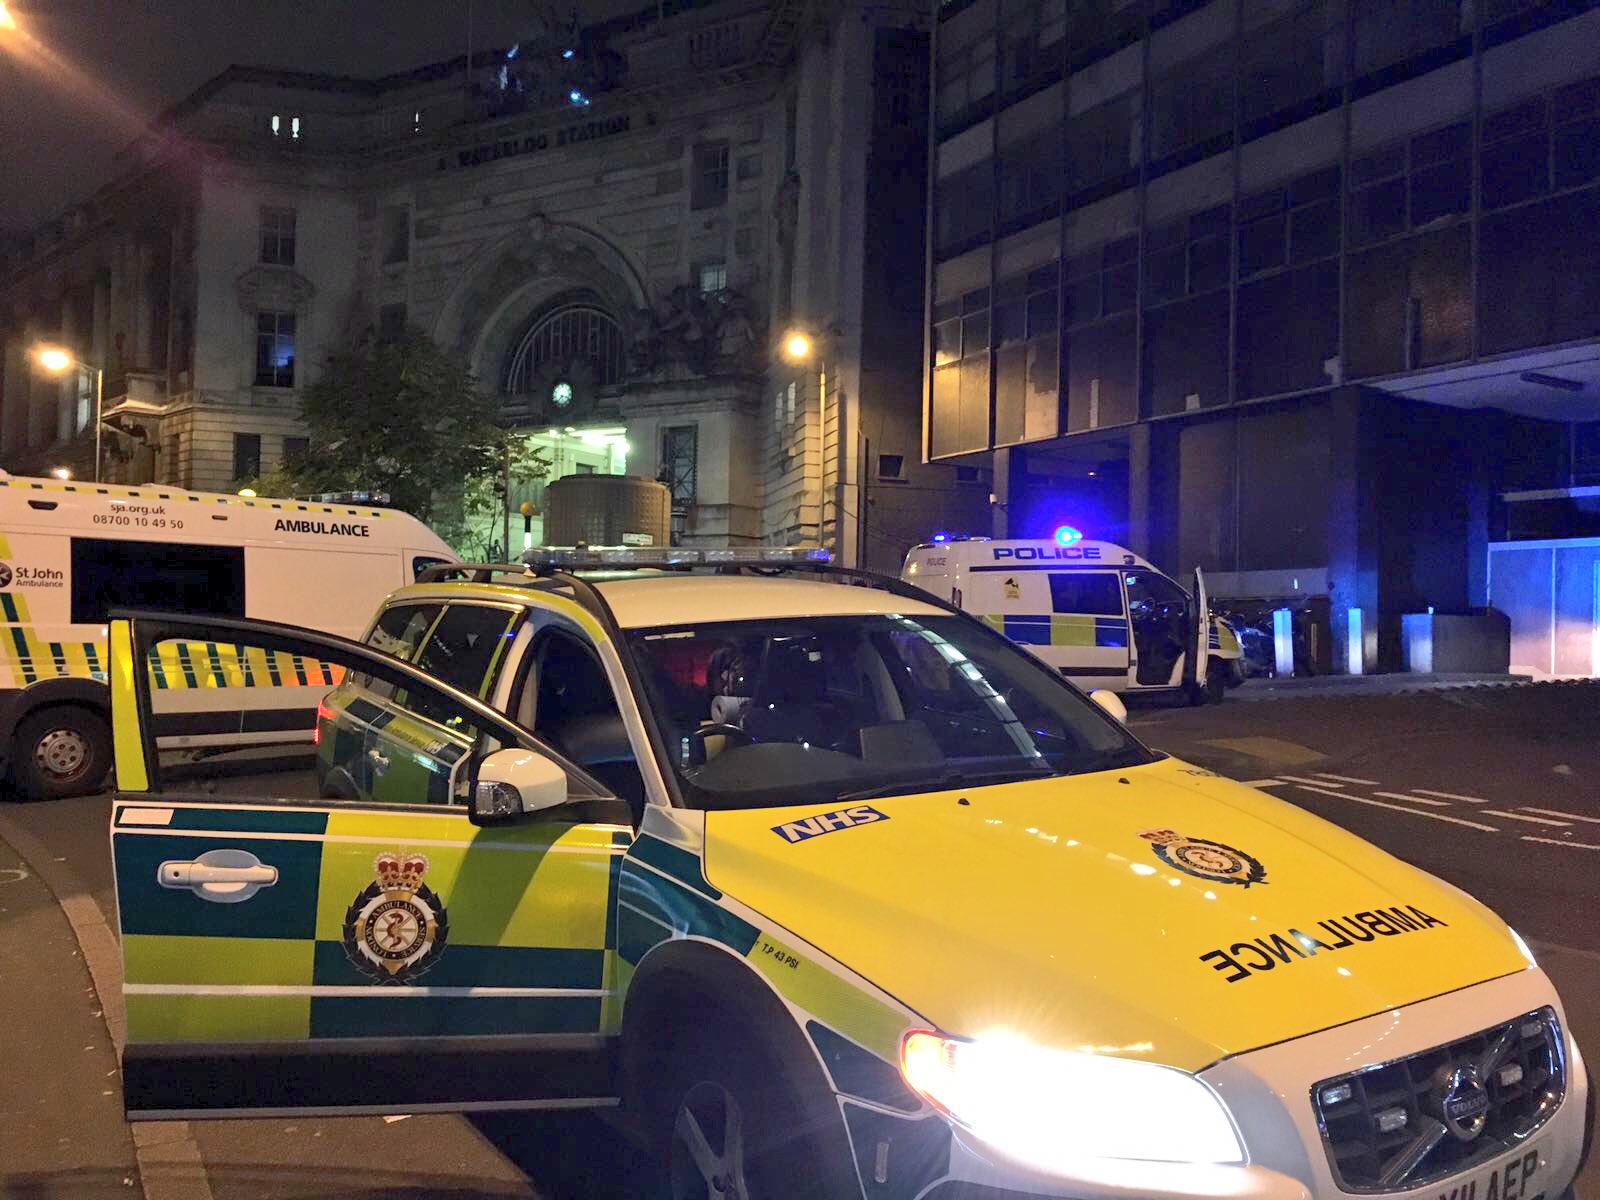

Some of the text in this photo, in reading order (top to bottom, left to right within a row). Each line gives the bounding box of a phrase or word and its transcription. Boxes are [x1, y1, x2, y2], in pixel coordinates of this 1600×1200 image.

[111, 504, 166, 515] sja.org.uk
[93, 514, 184, 529] 08700 10 49 50
[274, 519, 370, 537] AMBULANCE
[993, 547, 1102, 560] POLICE
[15, 566, 63, 579] St John
[15, 579, 64, 588] Ambulance
[780, 806, 881, 842] NHS
[372, 900, 422, 918] AMBULANCE
[774, 950, 786, 961] 43
[784, 955, 799, 968] PSI
